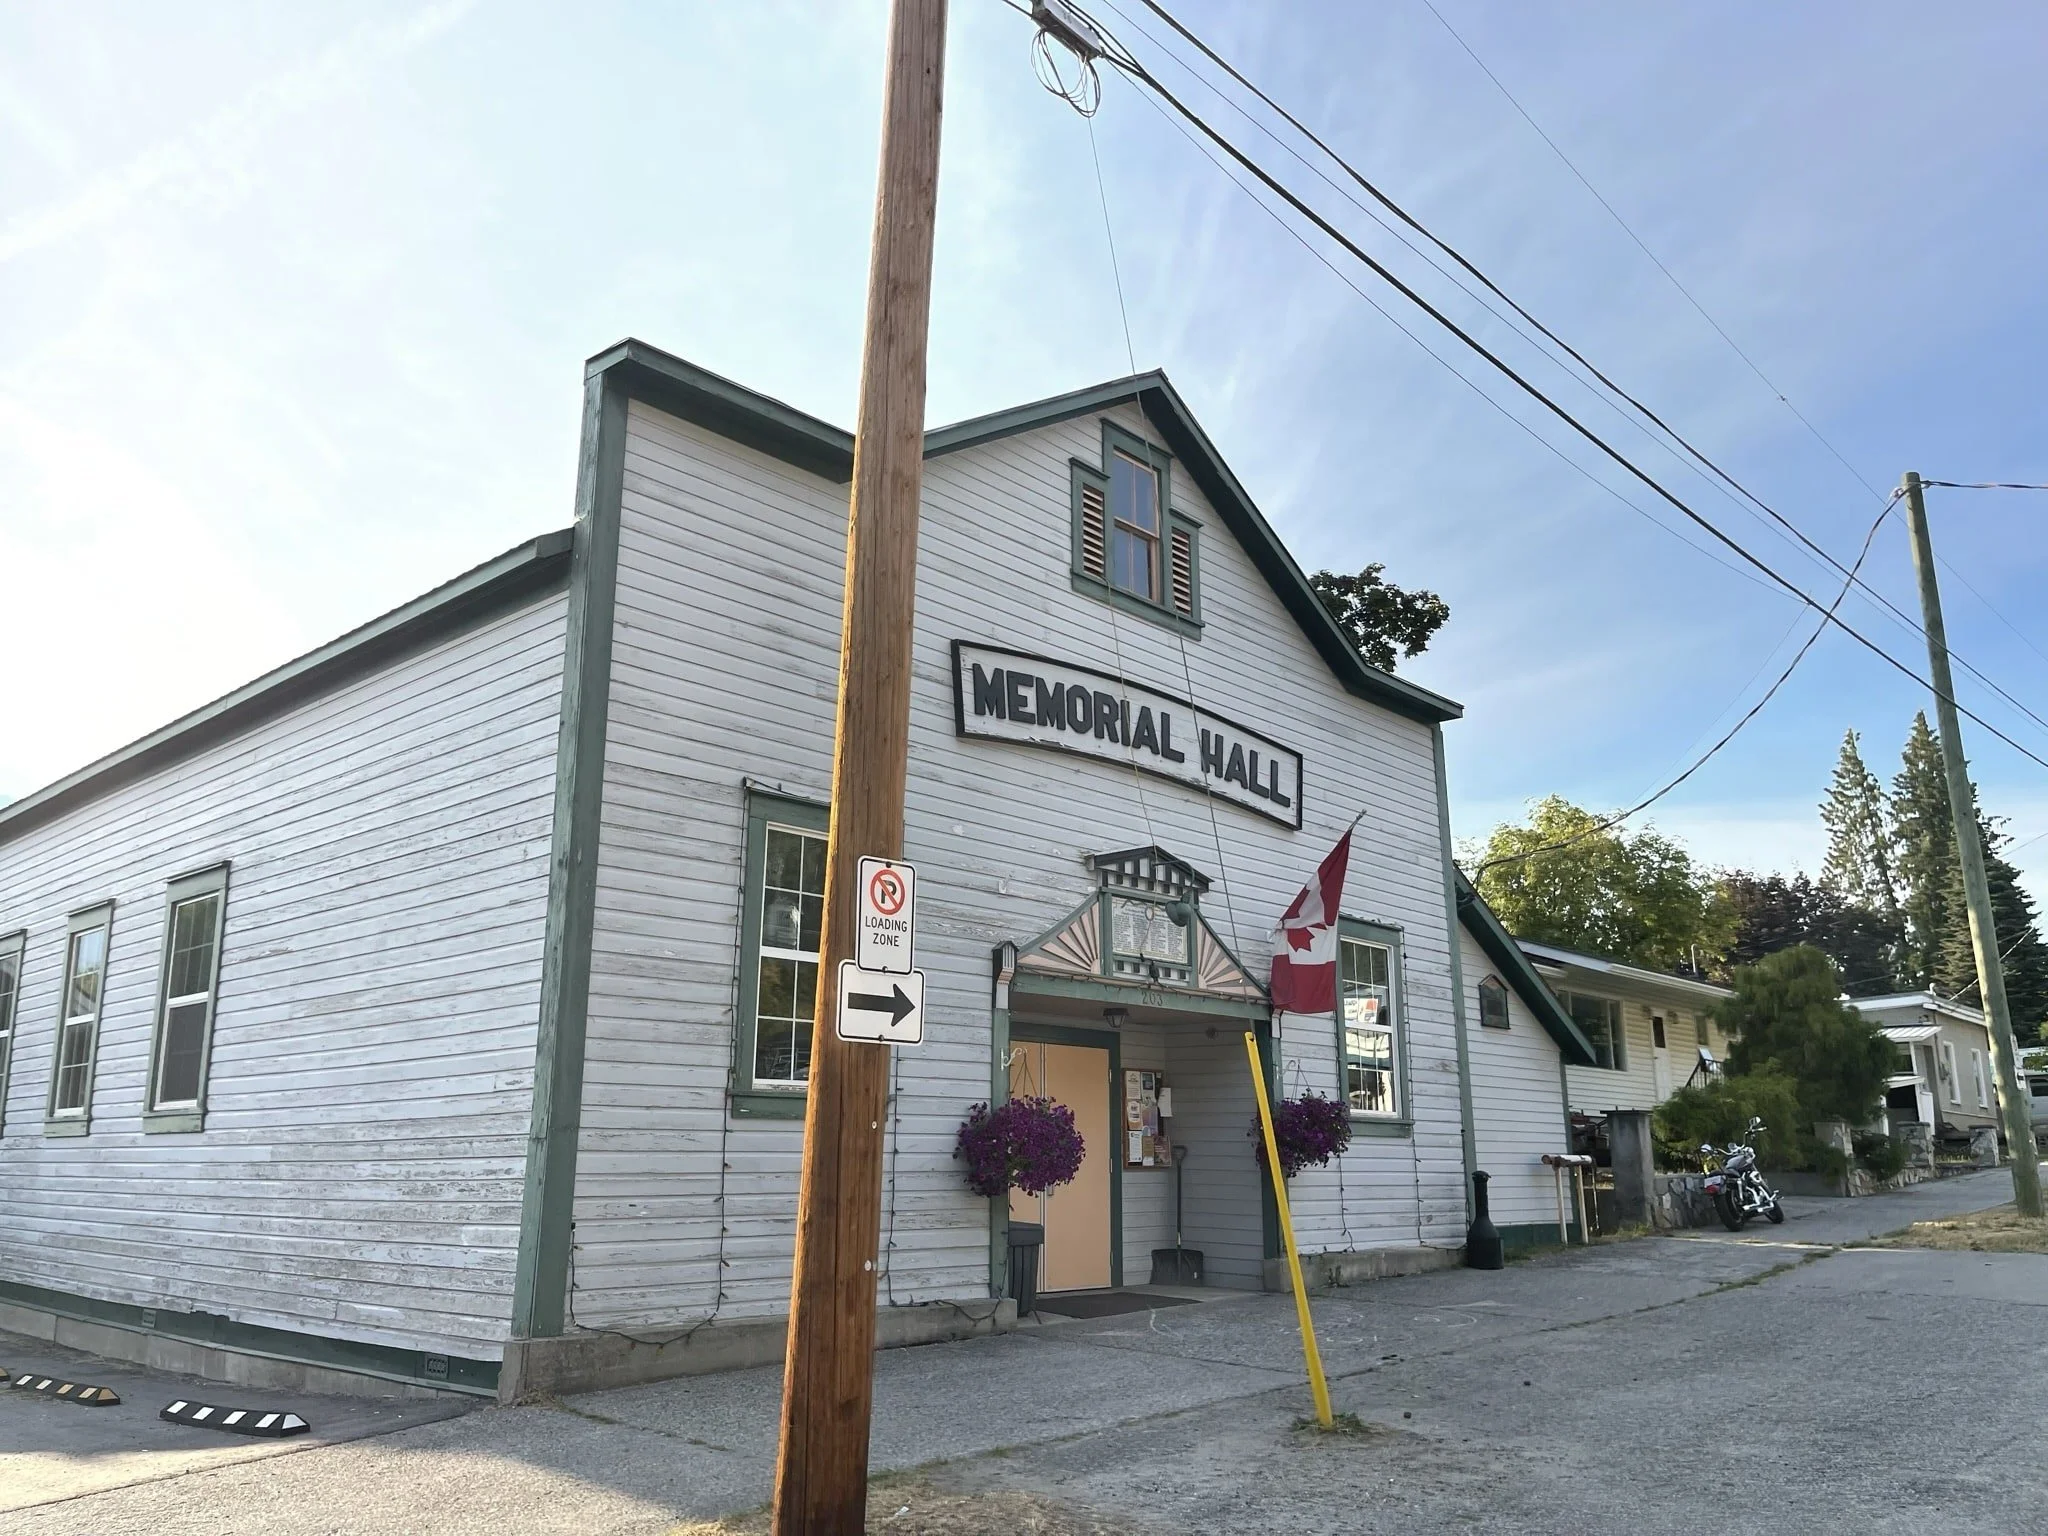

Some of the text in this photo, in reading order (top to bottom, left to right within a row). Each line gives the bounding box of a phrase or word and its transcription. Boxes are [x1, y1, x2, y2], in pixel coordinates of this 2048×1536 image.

[972, 663, 1291, 808] MEMORIAL HALL
[865, 916, 907, 932] LOADING
[872, 932, 899, 946] ZONE
[1141, 990, 1163, 1007] 203
